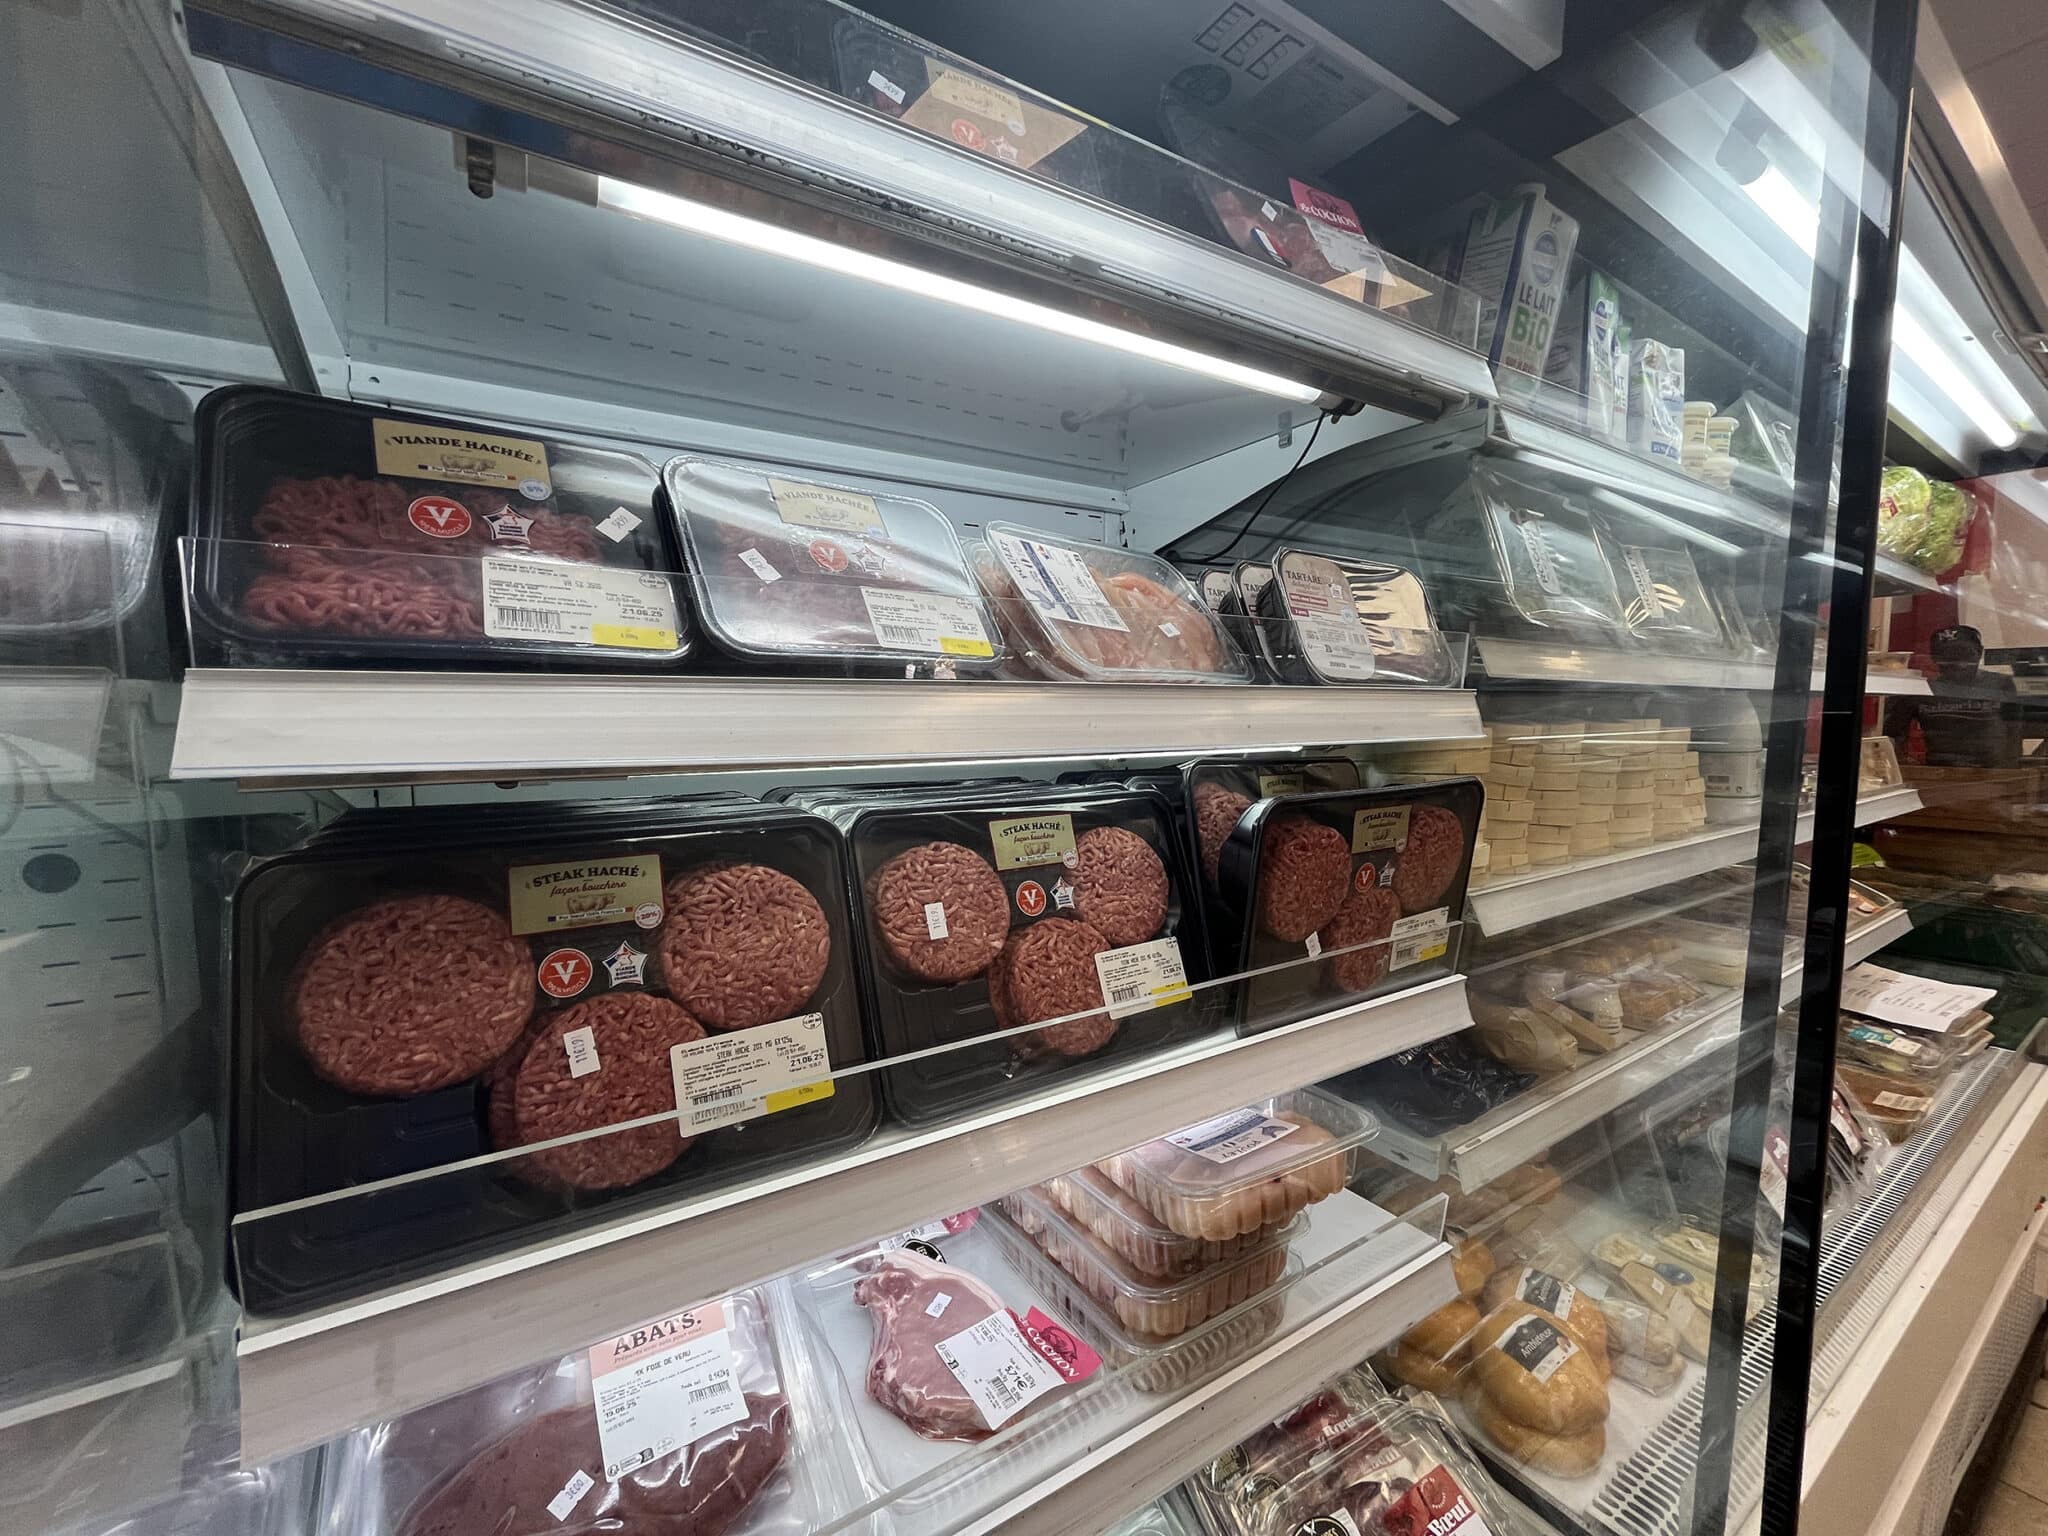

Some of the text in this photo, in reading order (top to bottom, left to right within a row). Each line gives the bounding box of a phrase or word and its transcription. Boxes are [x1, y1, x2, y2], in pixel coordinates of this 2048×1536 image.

[1310, 206, 1358, 229] COCHON
[1519, 282, 1557, 317] LE LAIT
[391, 435, 534, 464] VIANDE HACHÉE
[783, 490, 869, 512] VIANDE HACHÉE
[423, 505, 456, 527] V
[819, 546, 836, 563] V
[1285, 569, 1323, 585] TARTARE
[1207, 587, 1226, 598] TART
[622, 607, 664, 618] 21.06.25
[1002, 821, 1061, 837] STEAK HACHÉ
[533, 864, 640, 888] STEAK HACHÉ
[1361, 870, 1370, 884] V
[549, 883, 580, 898] façon
[1022, 888, 1038, 908] V
[551, 959, 580, 986] V
[790, 1053, 825, 1067] 21.06.25
[613, 1312, 702, 1356] ABATS.
[645, 1361, 662, 1374] FOIE
[663, 1358, 673, 1366] DE
[674, 1350, 691, 1362] VEAU
[1027, 1327, 1080, 1378] COCHON
[1426, 1494, 1472, 1535] Bœuf
